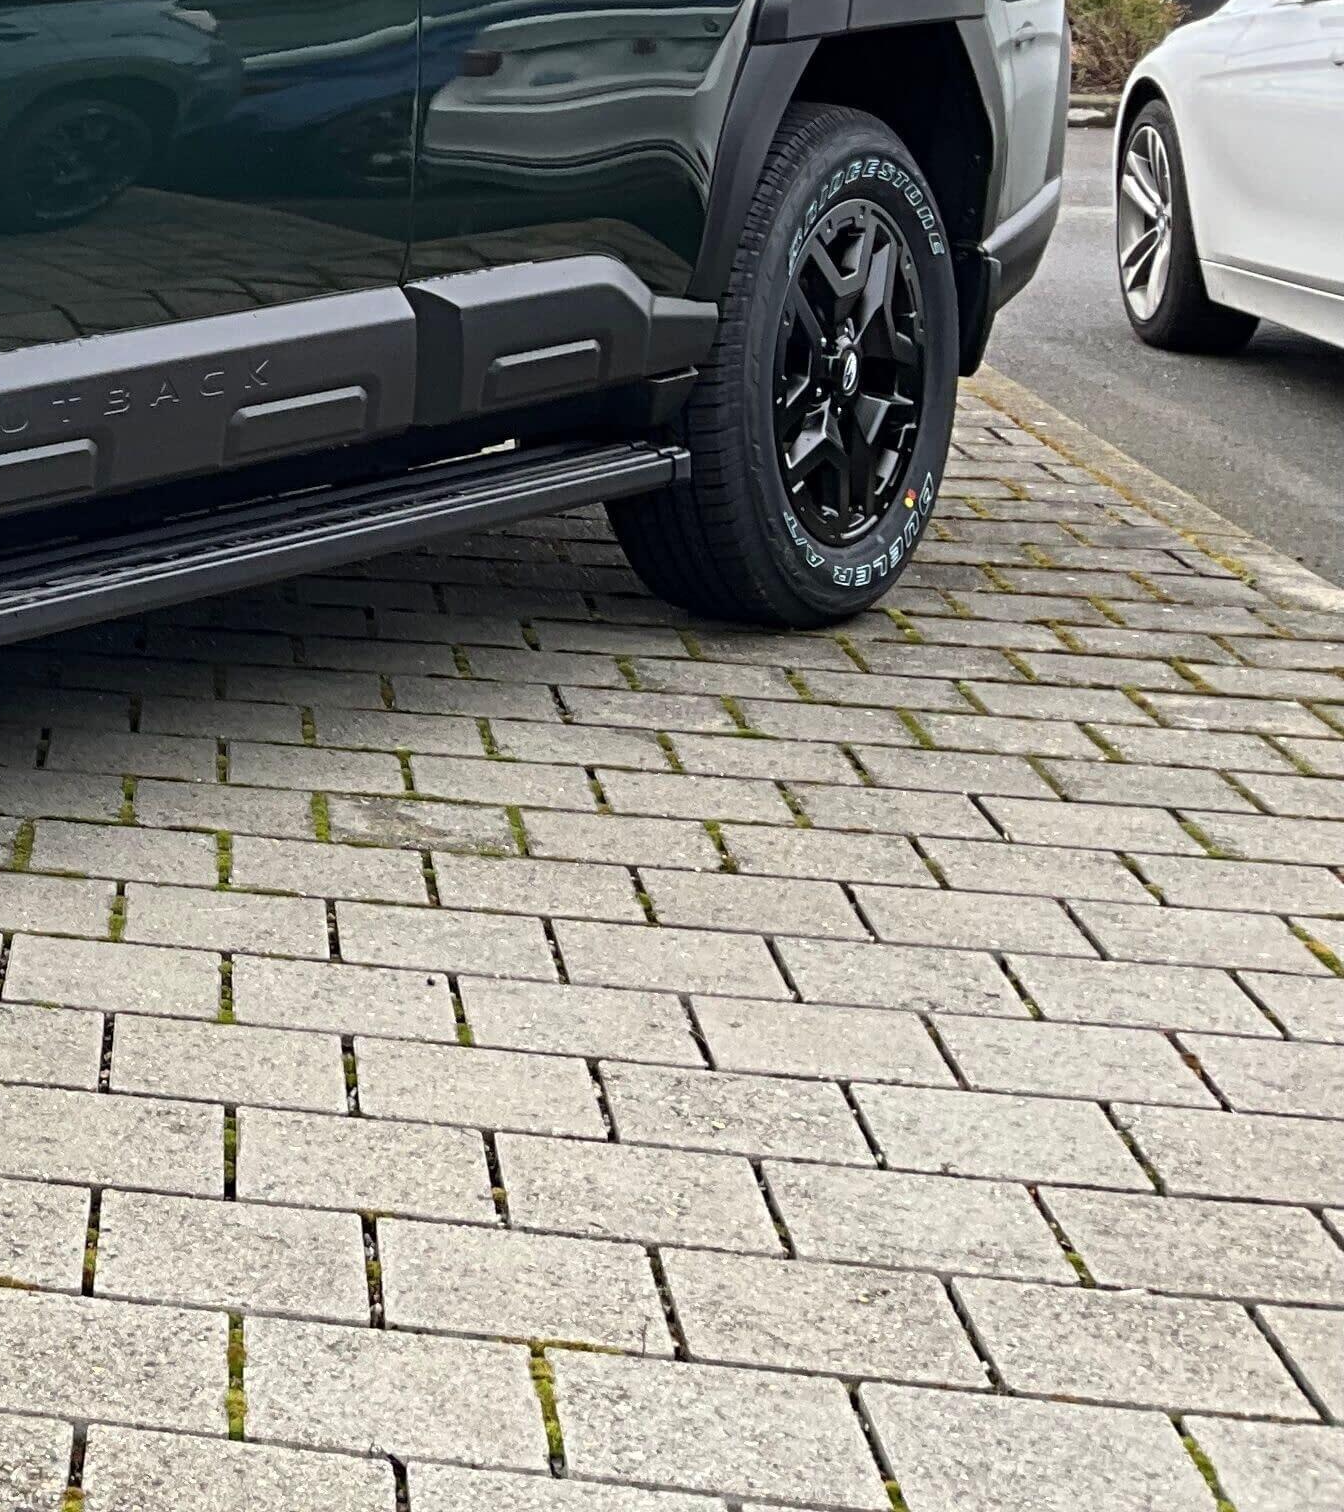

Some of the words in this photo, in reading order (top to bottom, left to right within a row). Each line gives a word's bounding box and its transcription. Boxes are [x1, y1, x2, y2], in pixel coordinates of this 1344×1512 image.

[788, 158, 946, 277] BRIDGESTONE
[782, 511, 826, 568] A/T
[832, 471, 935, 587] DUELER
